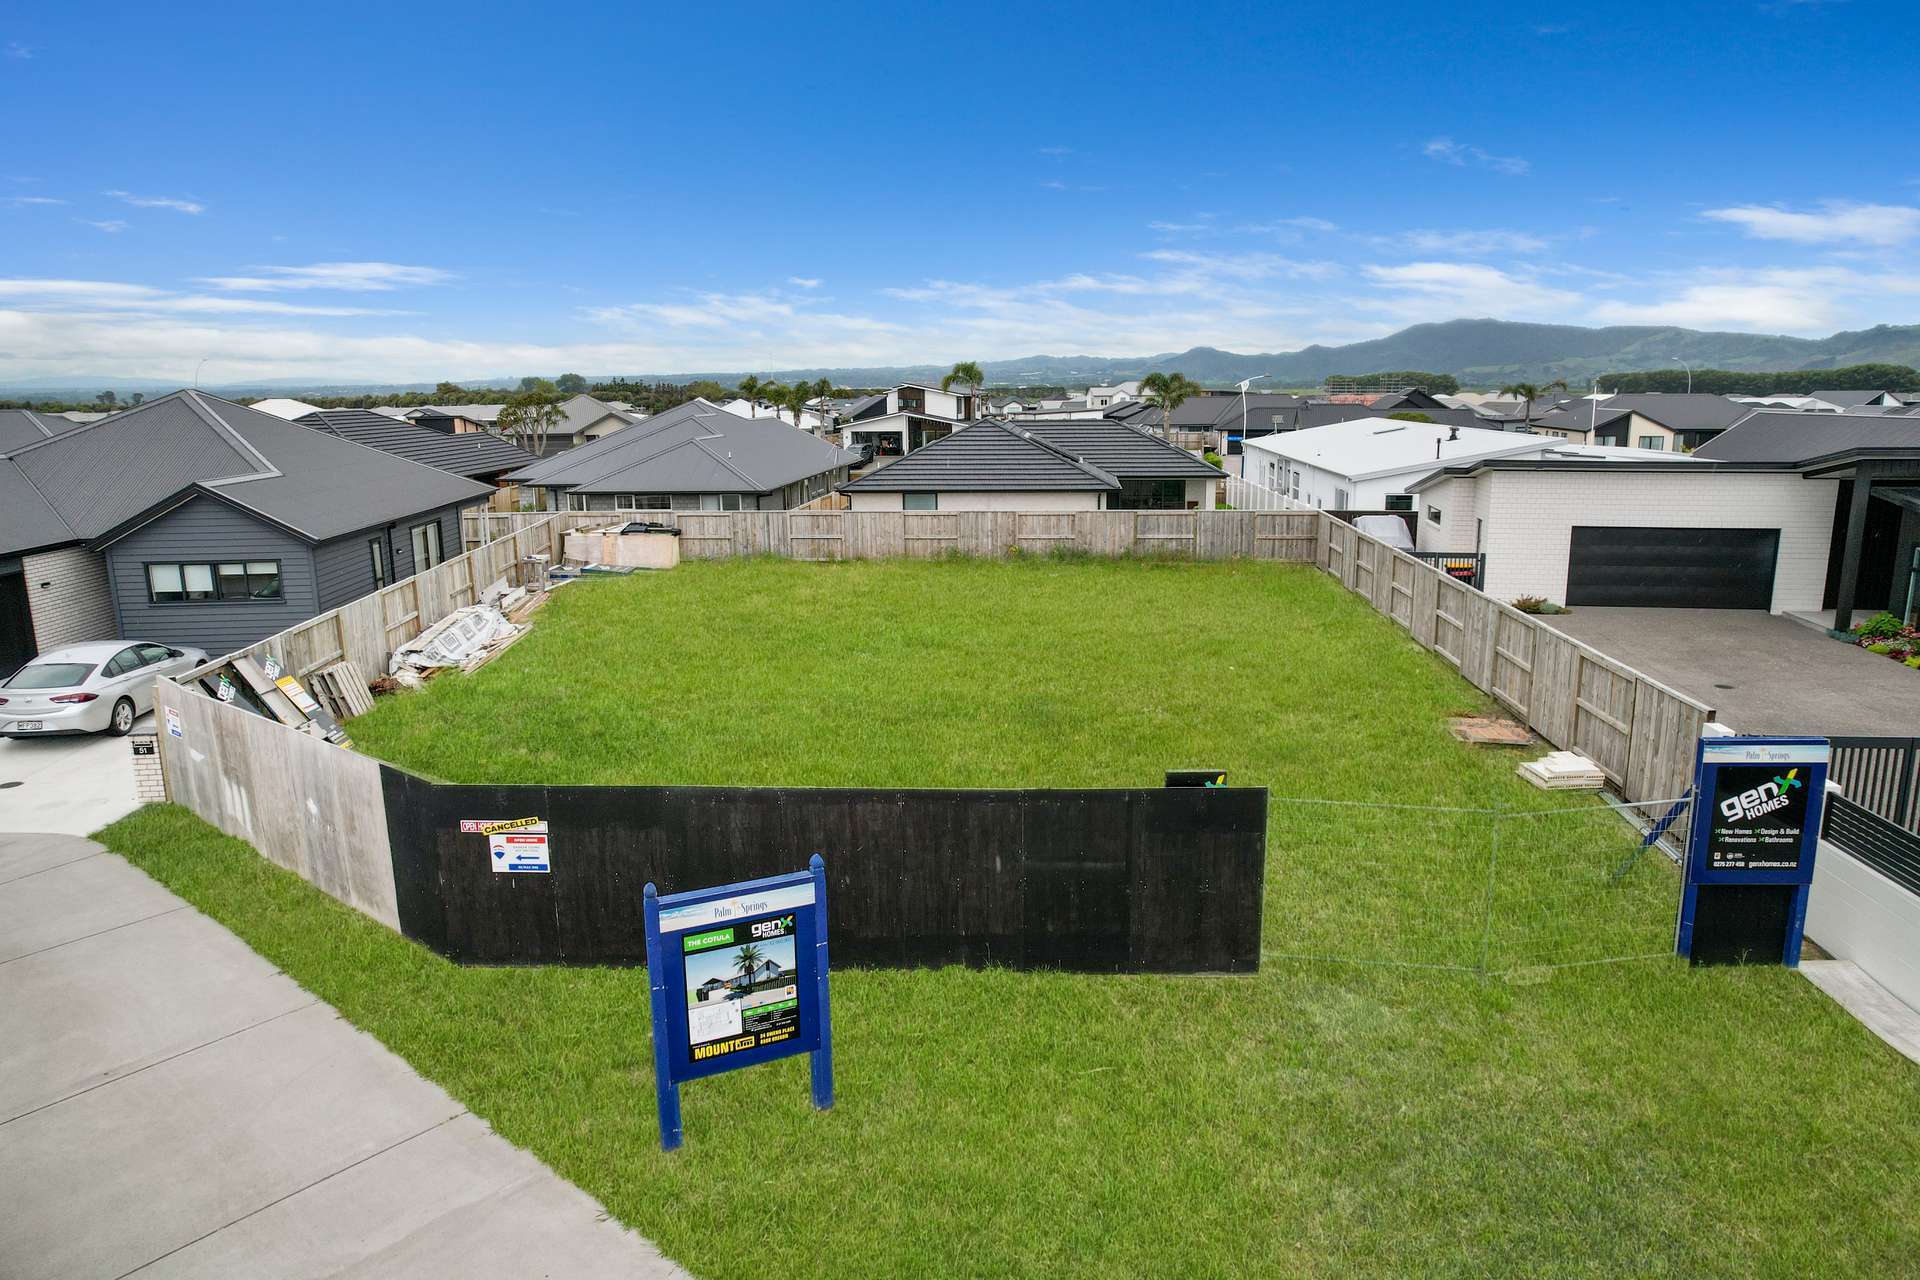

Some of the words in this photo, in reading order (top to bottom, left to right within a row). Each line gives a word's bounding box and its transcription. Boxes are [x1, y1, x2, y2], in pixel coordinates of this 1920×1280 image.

[1745, 751, 1761, 760] Palm
[1768, 751, 1791, 761] Springs
[1744, 795, 1790, 820] HOMES
[484, 818, 538, 834] CANCELLED
[1760, 828, 1779, 836] Design
[1785, 827, 1800, 835] Build
[714, 906, 732, 919] Palm
[740, 900, 768, 914] Springs
[687, 938, 702, 948] THE
[702, 934, 731, 945] COTULA
[762, 928, 785, 939] HOMES
[694, 1040, 735, 1060] MOUNT
